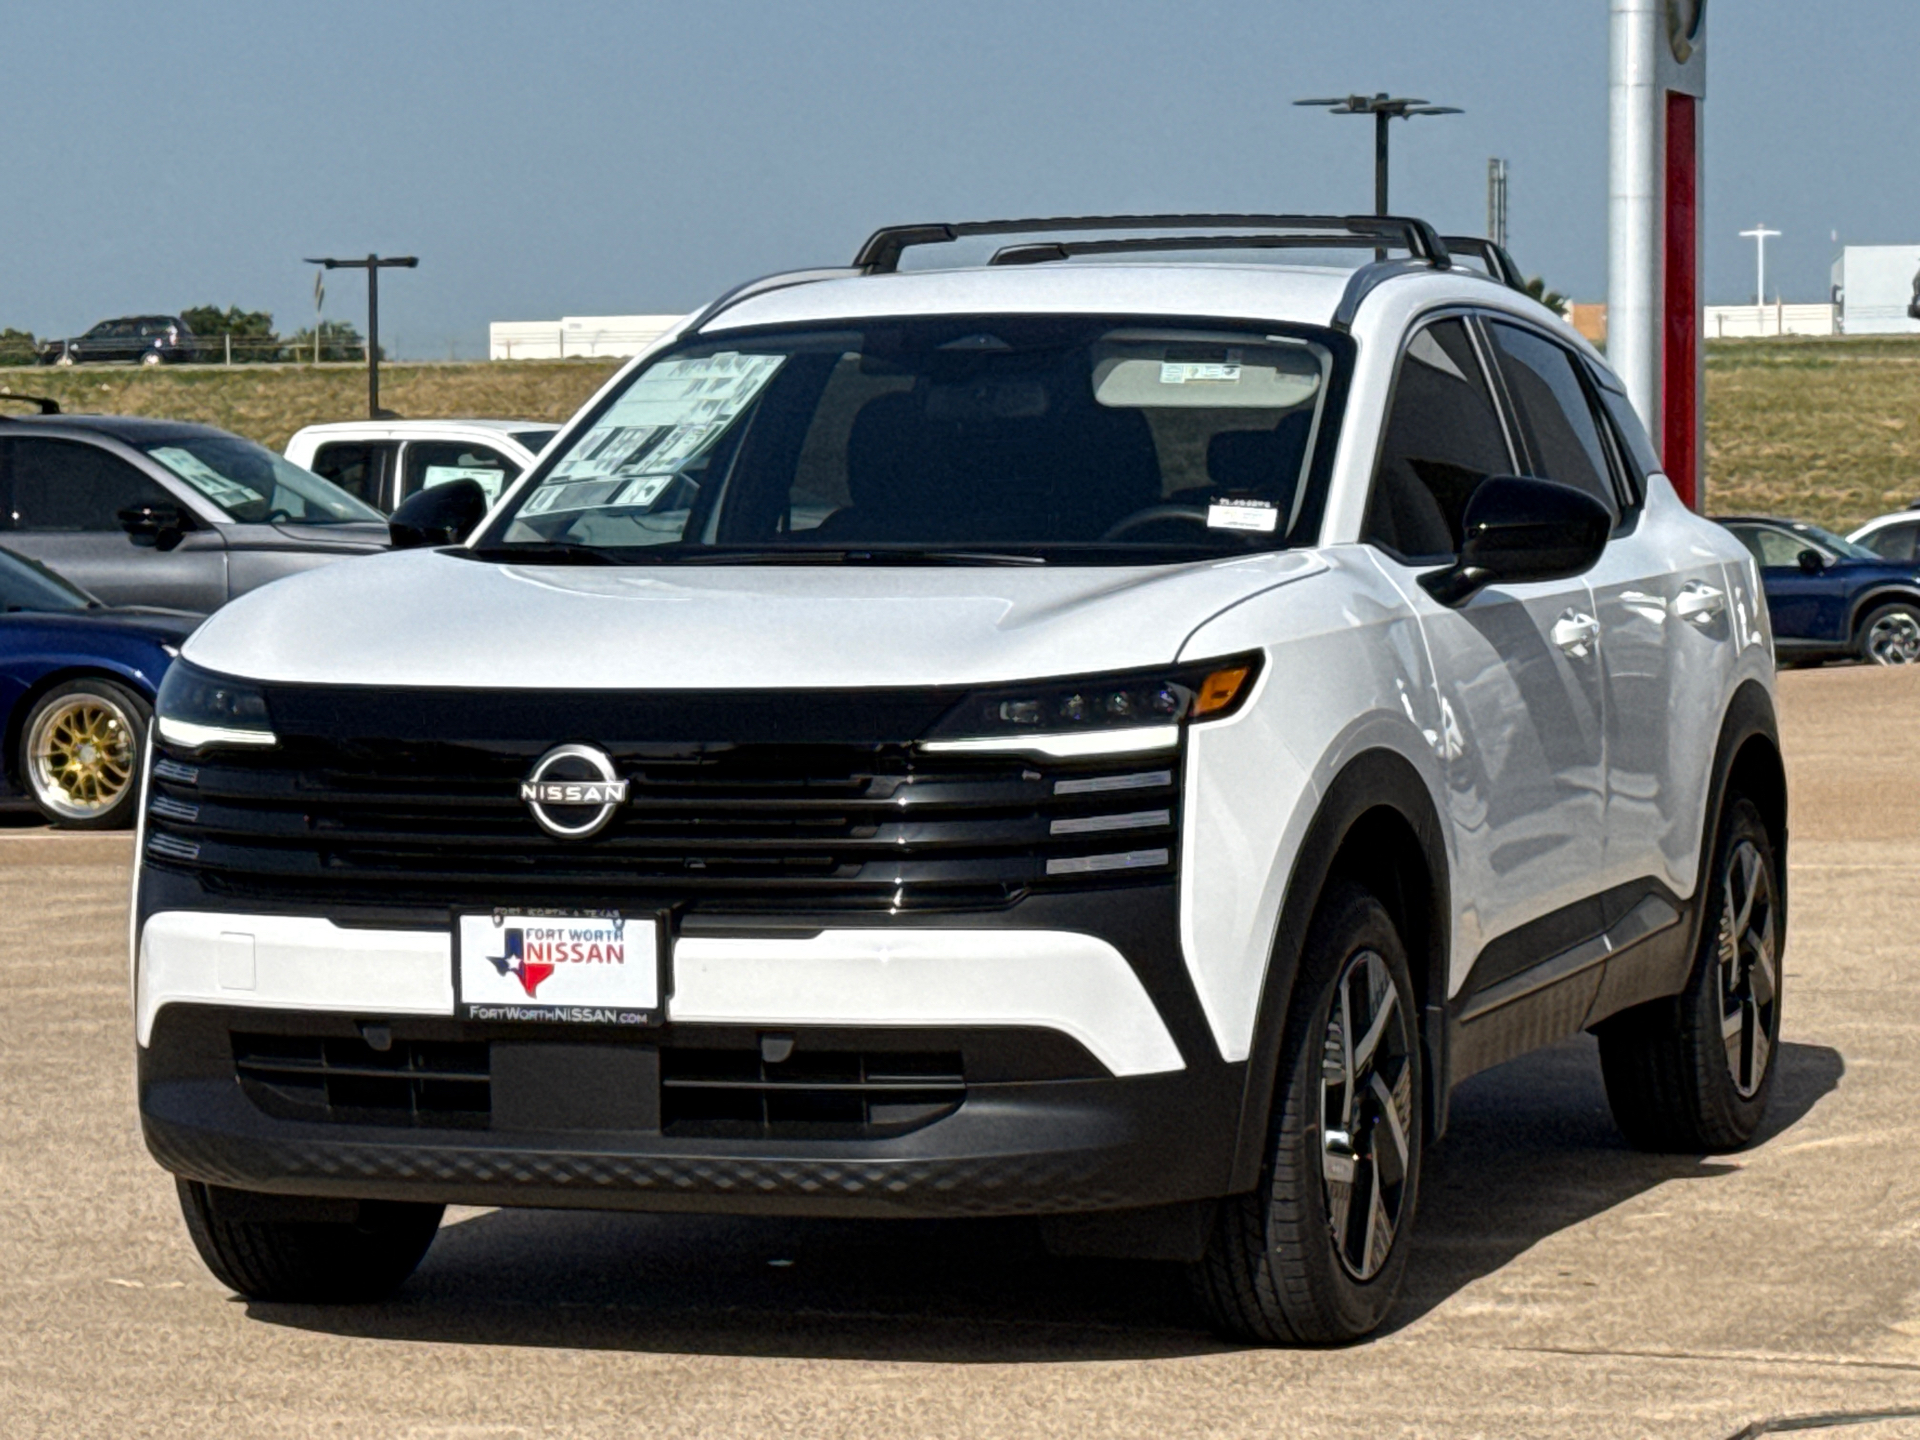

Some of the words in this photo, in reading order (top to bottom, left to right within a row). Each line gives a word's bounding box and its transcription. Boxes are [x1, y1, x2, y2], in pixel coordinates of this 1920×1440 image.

[521, 784, 624, 801] NISSAN
[526, 928, 565, 941] FORT
[568, 929, 624, 942] WORTH
[526, 942, 625, 964] NISSAN
